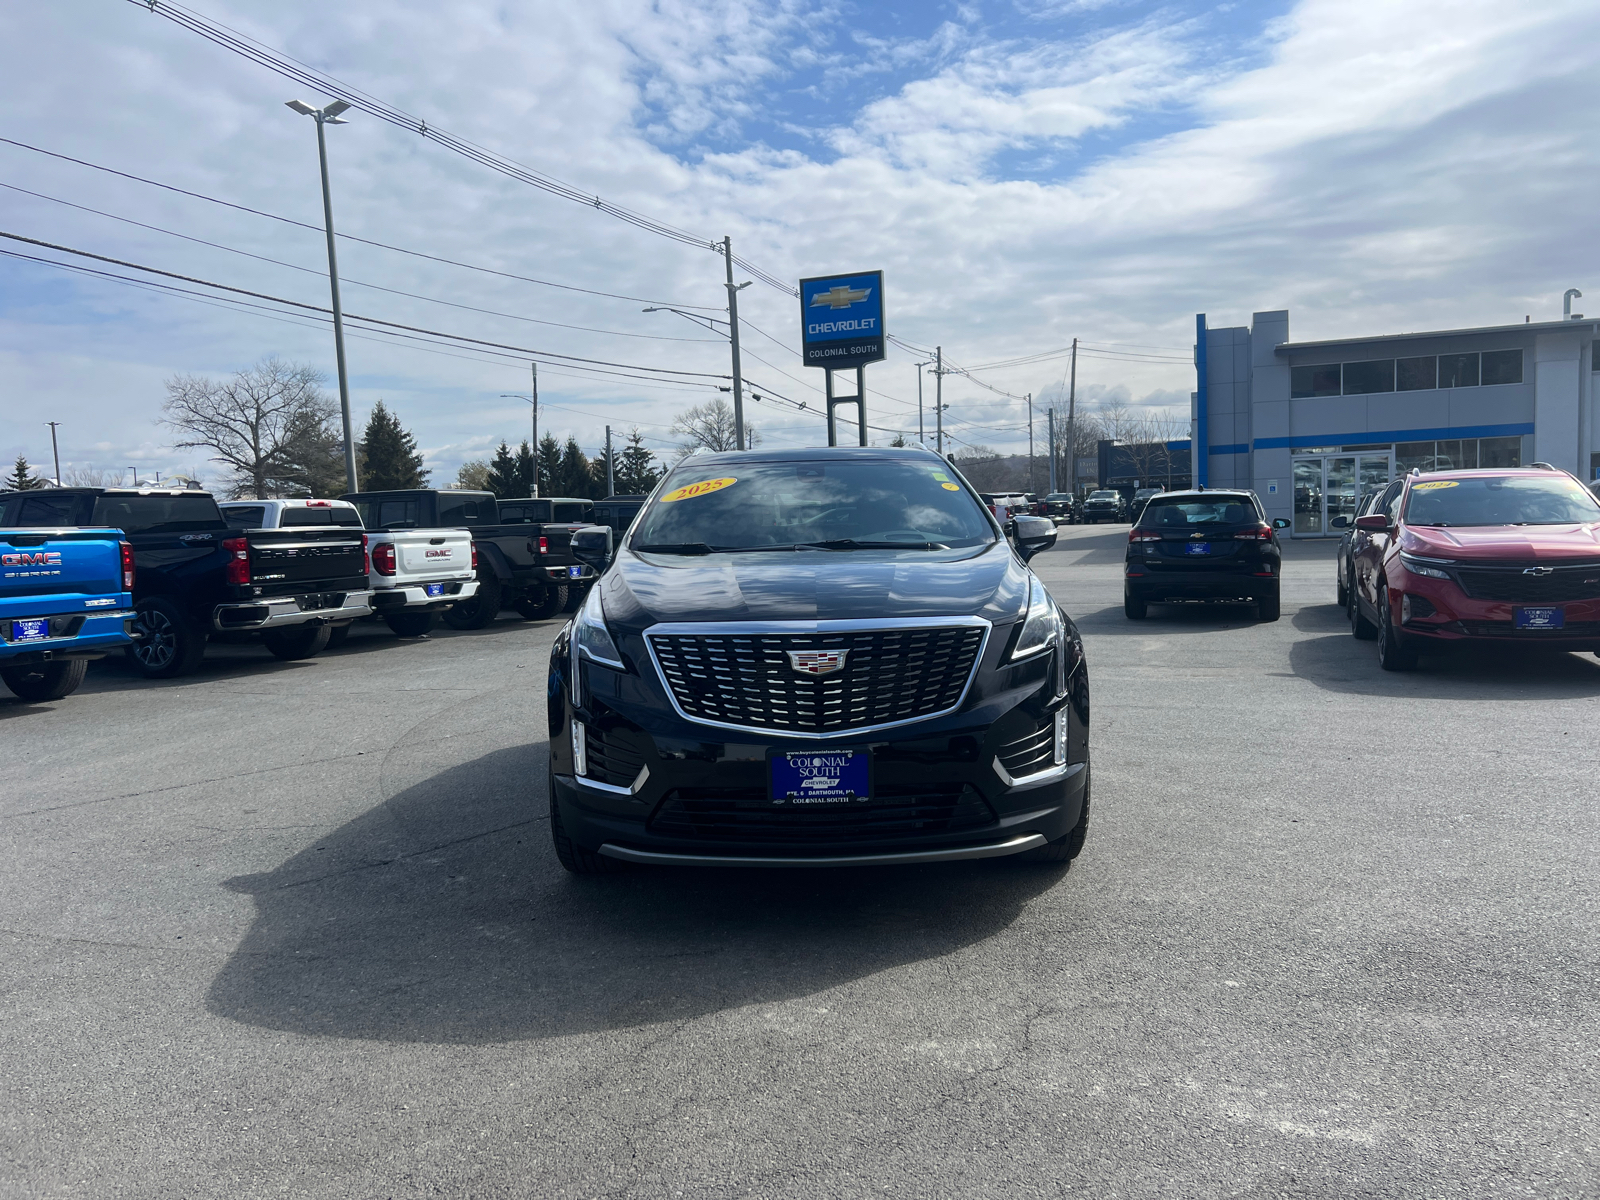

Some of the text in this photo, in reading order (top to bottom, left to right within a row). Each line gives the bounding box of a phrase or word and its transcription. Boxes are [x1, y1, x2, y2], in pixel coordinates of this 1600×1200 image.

[808, 318, 876, 334] CHEVROLET
[809, 345, 878, 358] COLONIAL SOUTH
[675, 478, 724, 500] 2025
[260, 546, 360, 559] CHEVROLET
[425, 549, 452, 558] GMC
[1, 552, 62, 567] GMC
[4, 570, 61, 578] SIERRA
[790, 757, 850, 768] COLONIAL
[799, 767, 841, 777] SOUTH
